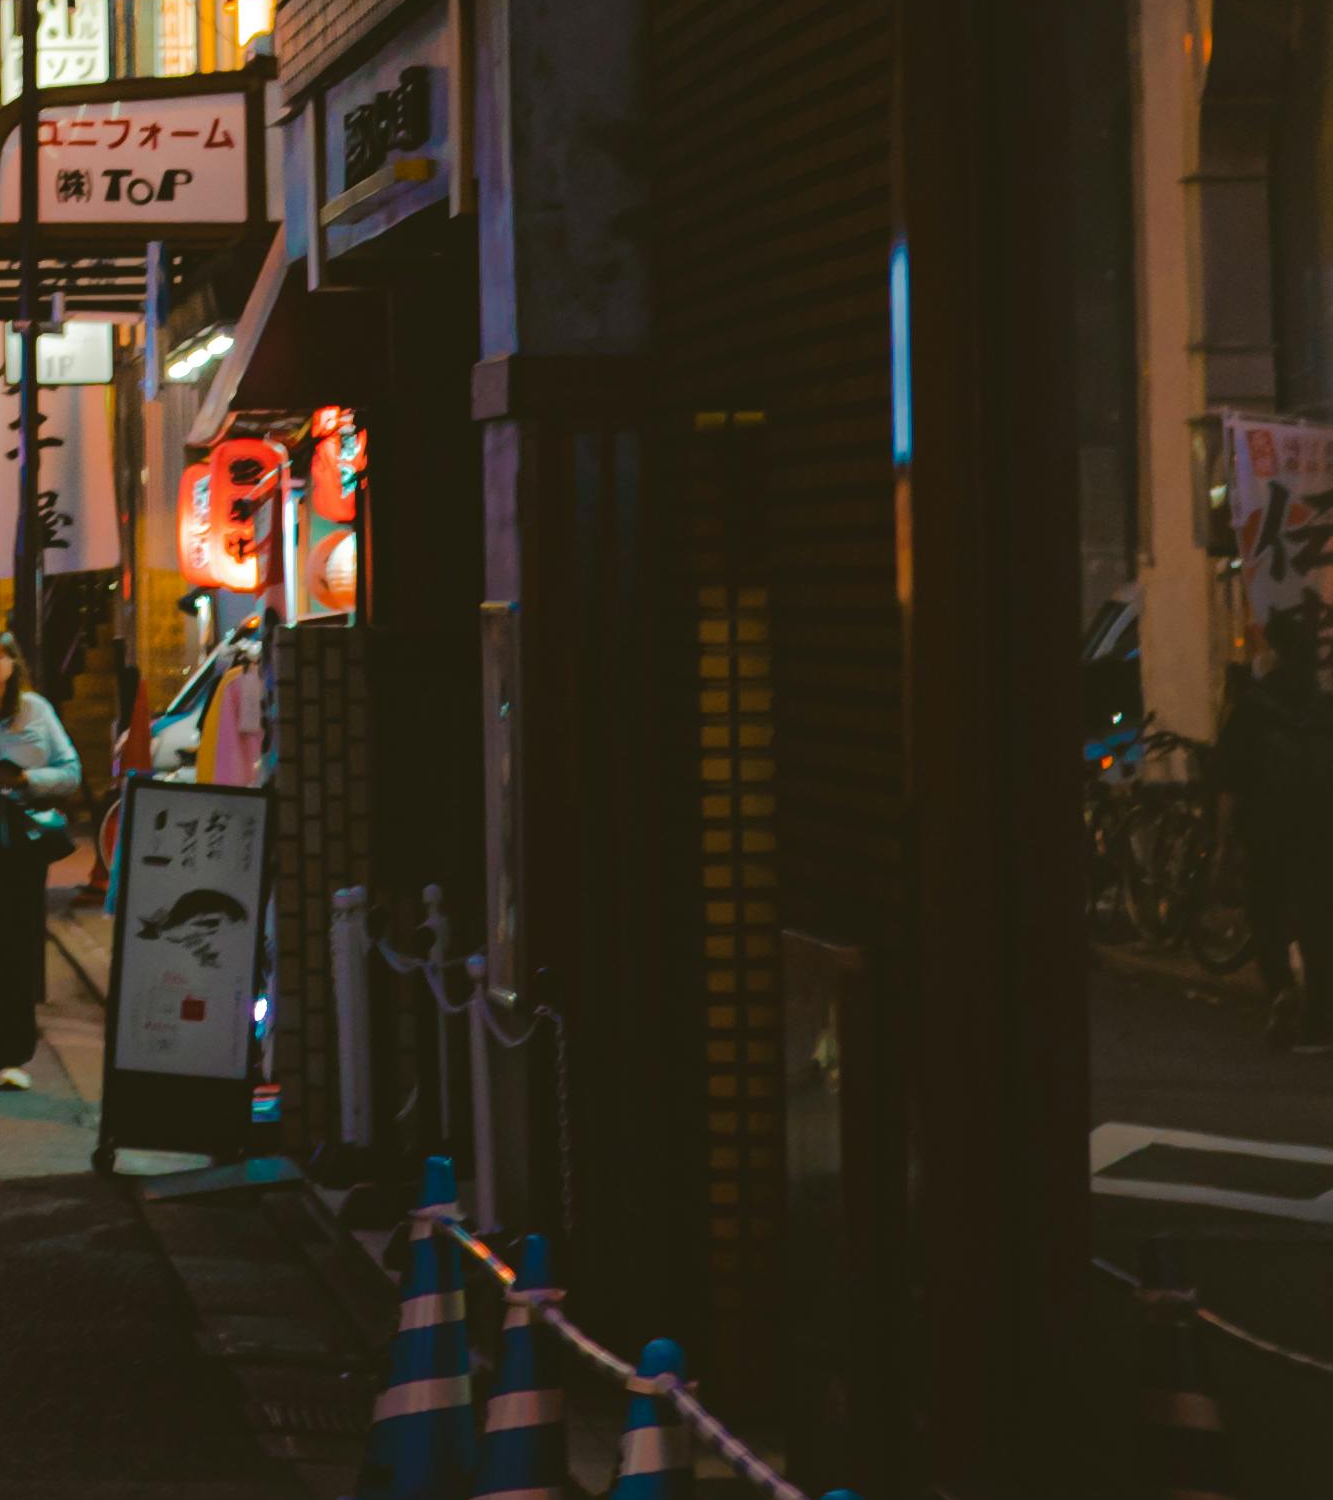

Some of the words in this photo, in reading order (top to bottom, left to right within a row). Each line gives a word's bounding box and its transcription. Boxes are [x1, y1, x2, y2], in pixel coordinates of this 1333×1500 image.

[38, 117, 234, 149] ユニフォーム
